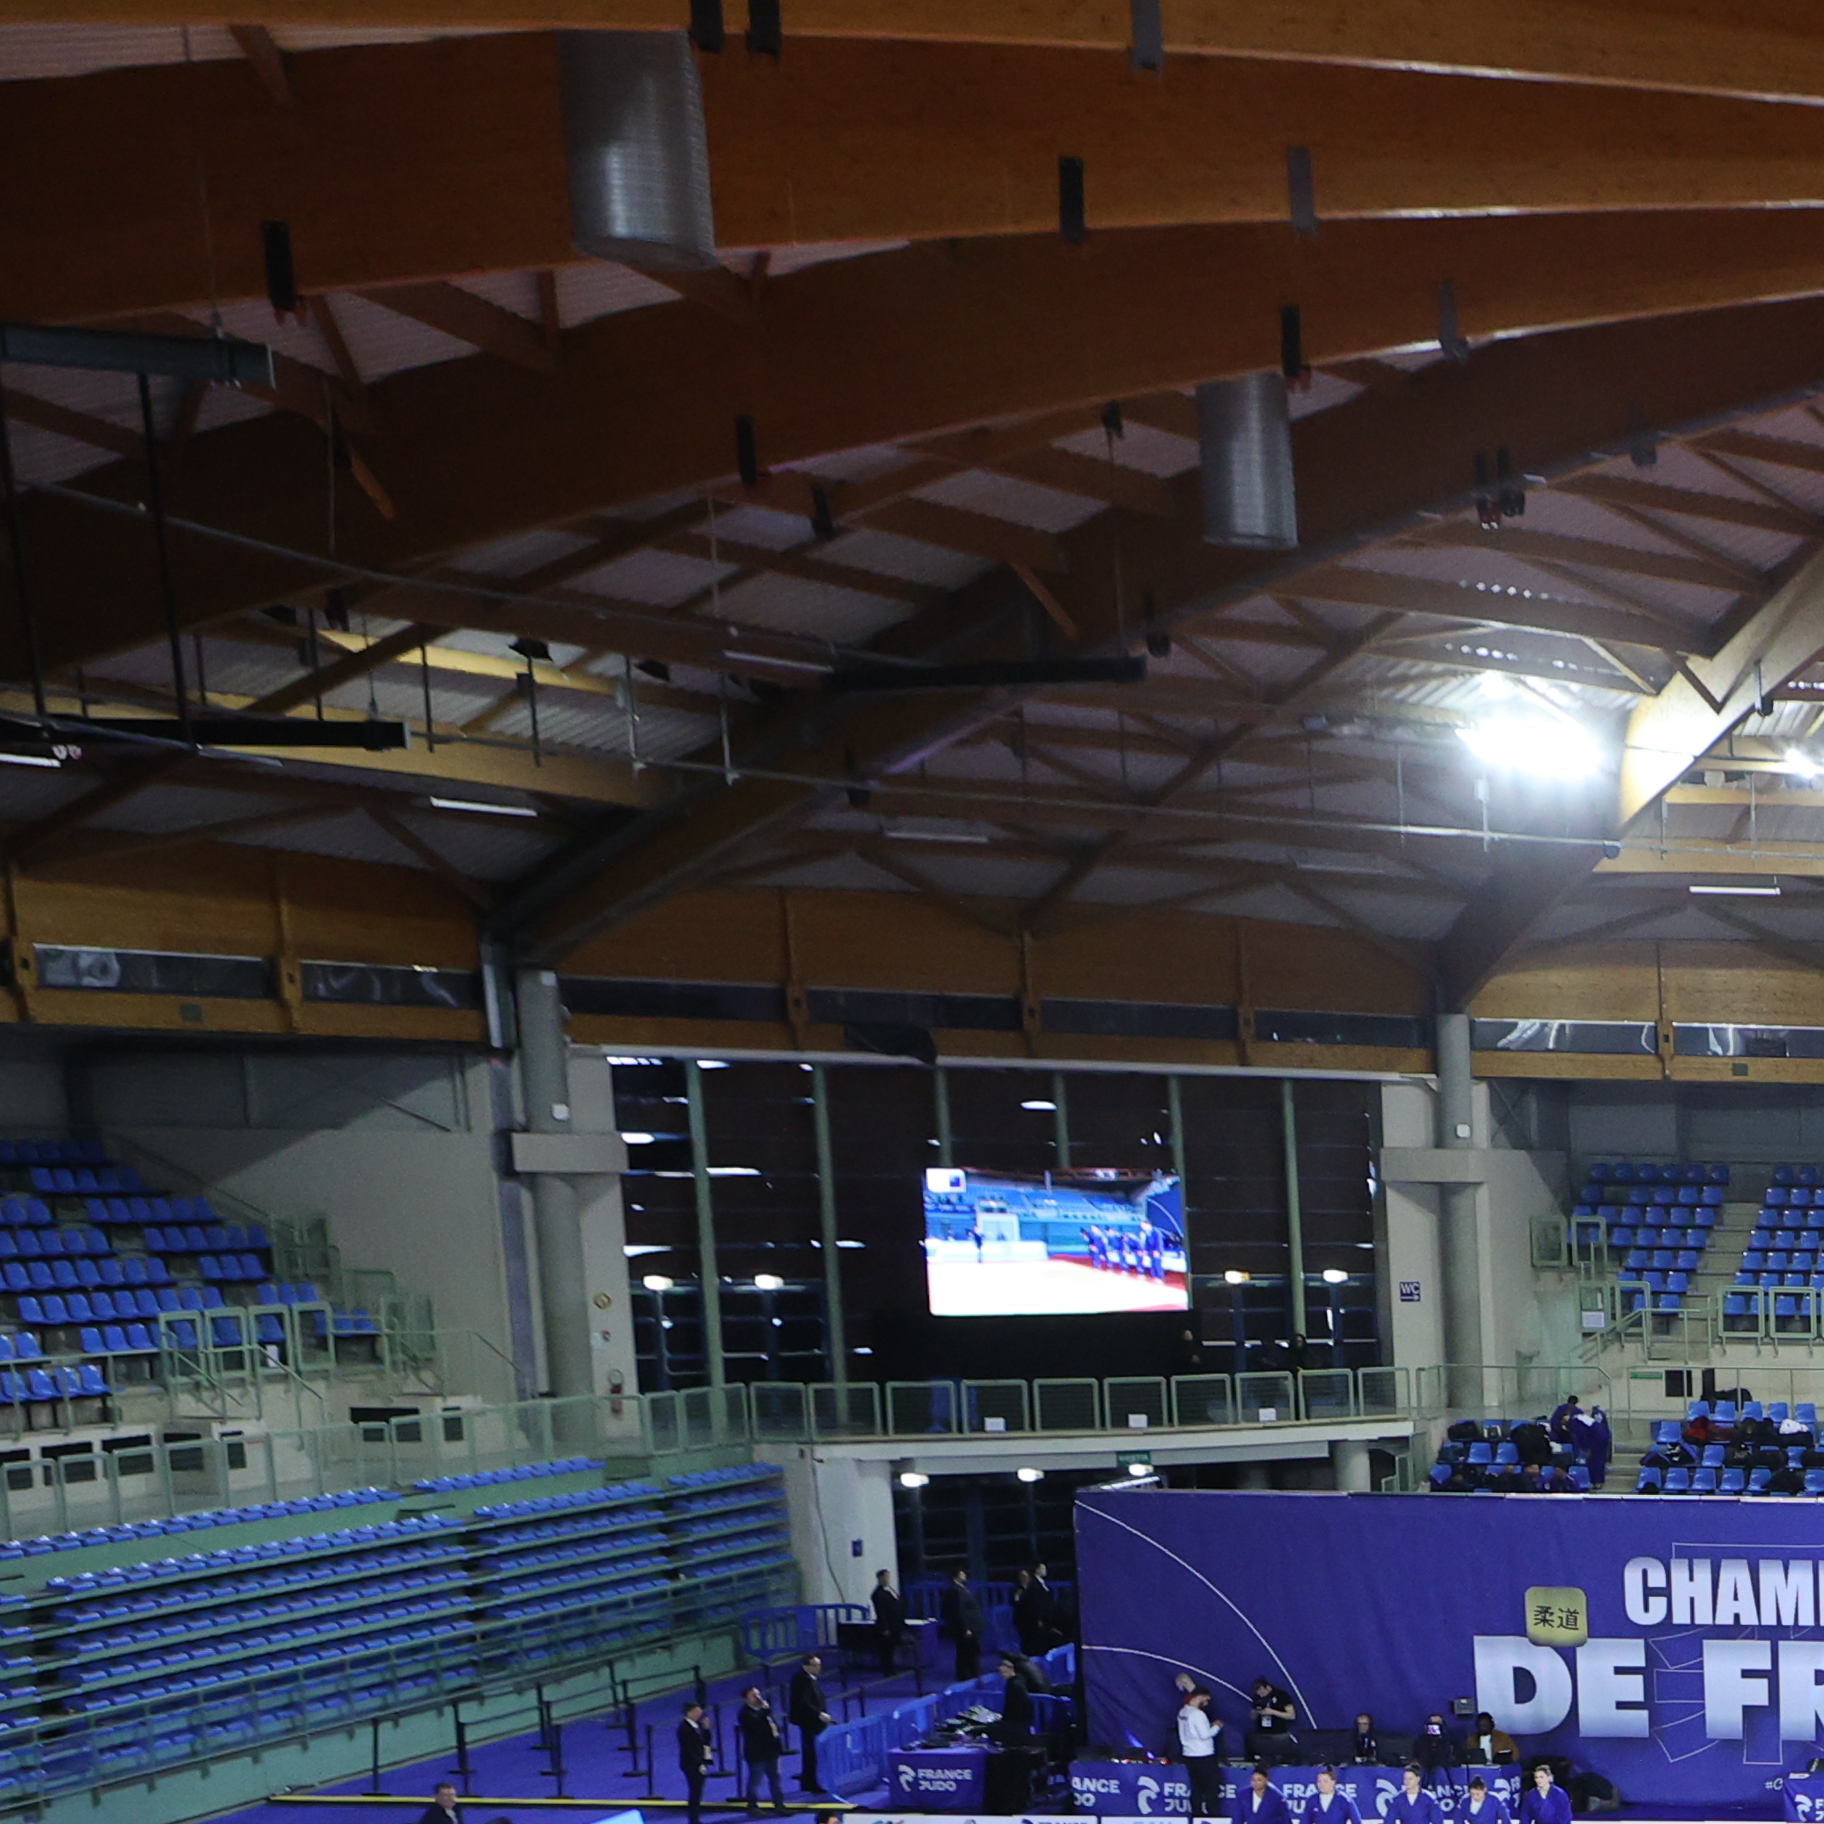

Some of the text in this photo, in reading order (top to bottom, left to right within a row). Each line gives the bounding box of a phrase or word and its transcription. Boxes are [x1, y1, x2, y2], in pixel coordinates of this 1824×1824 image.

[1533, 1604, 1581, 1631] 柔道
[1473, 1635, 1650, 1739] DE
[917, 1769, 973, 1783] FRANCE
[918, 1781, 957, 1794] JUDO
